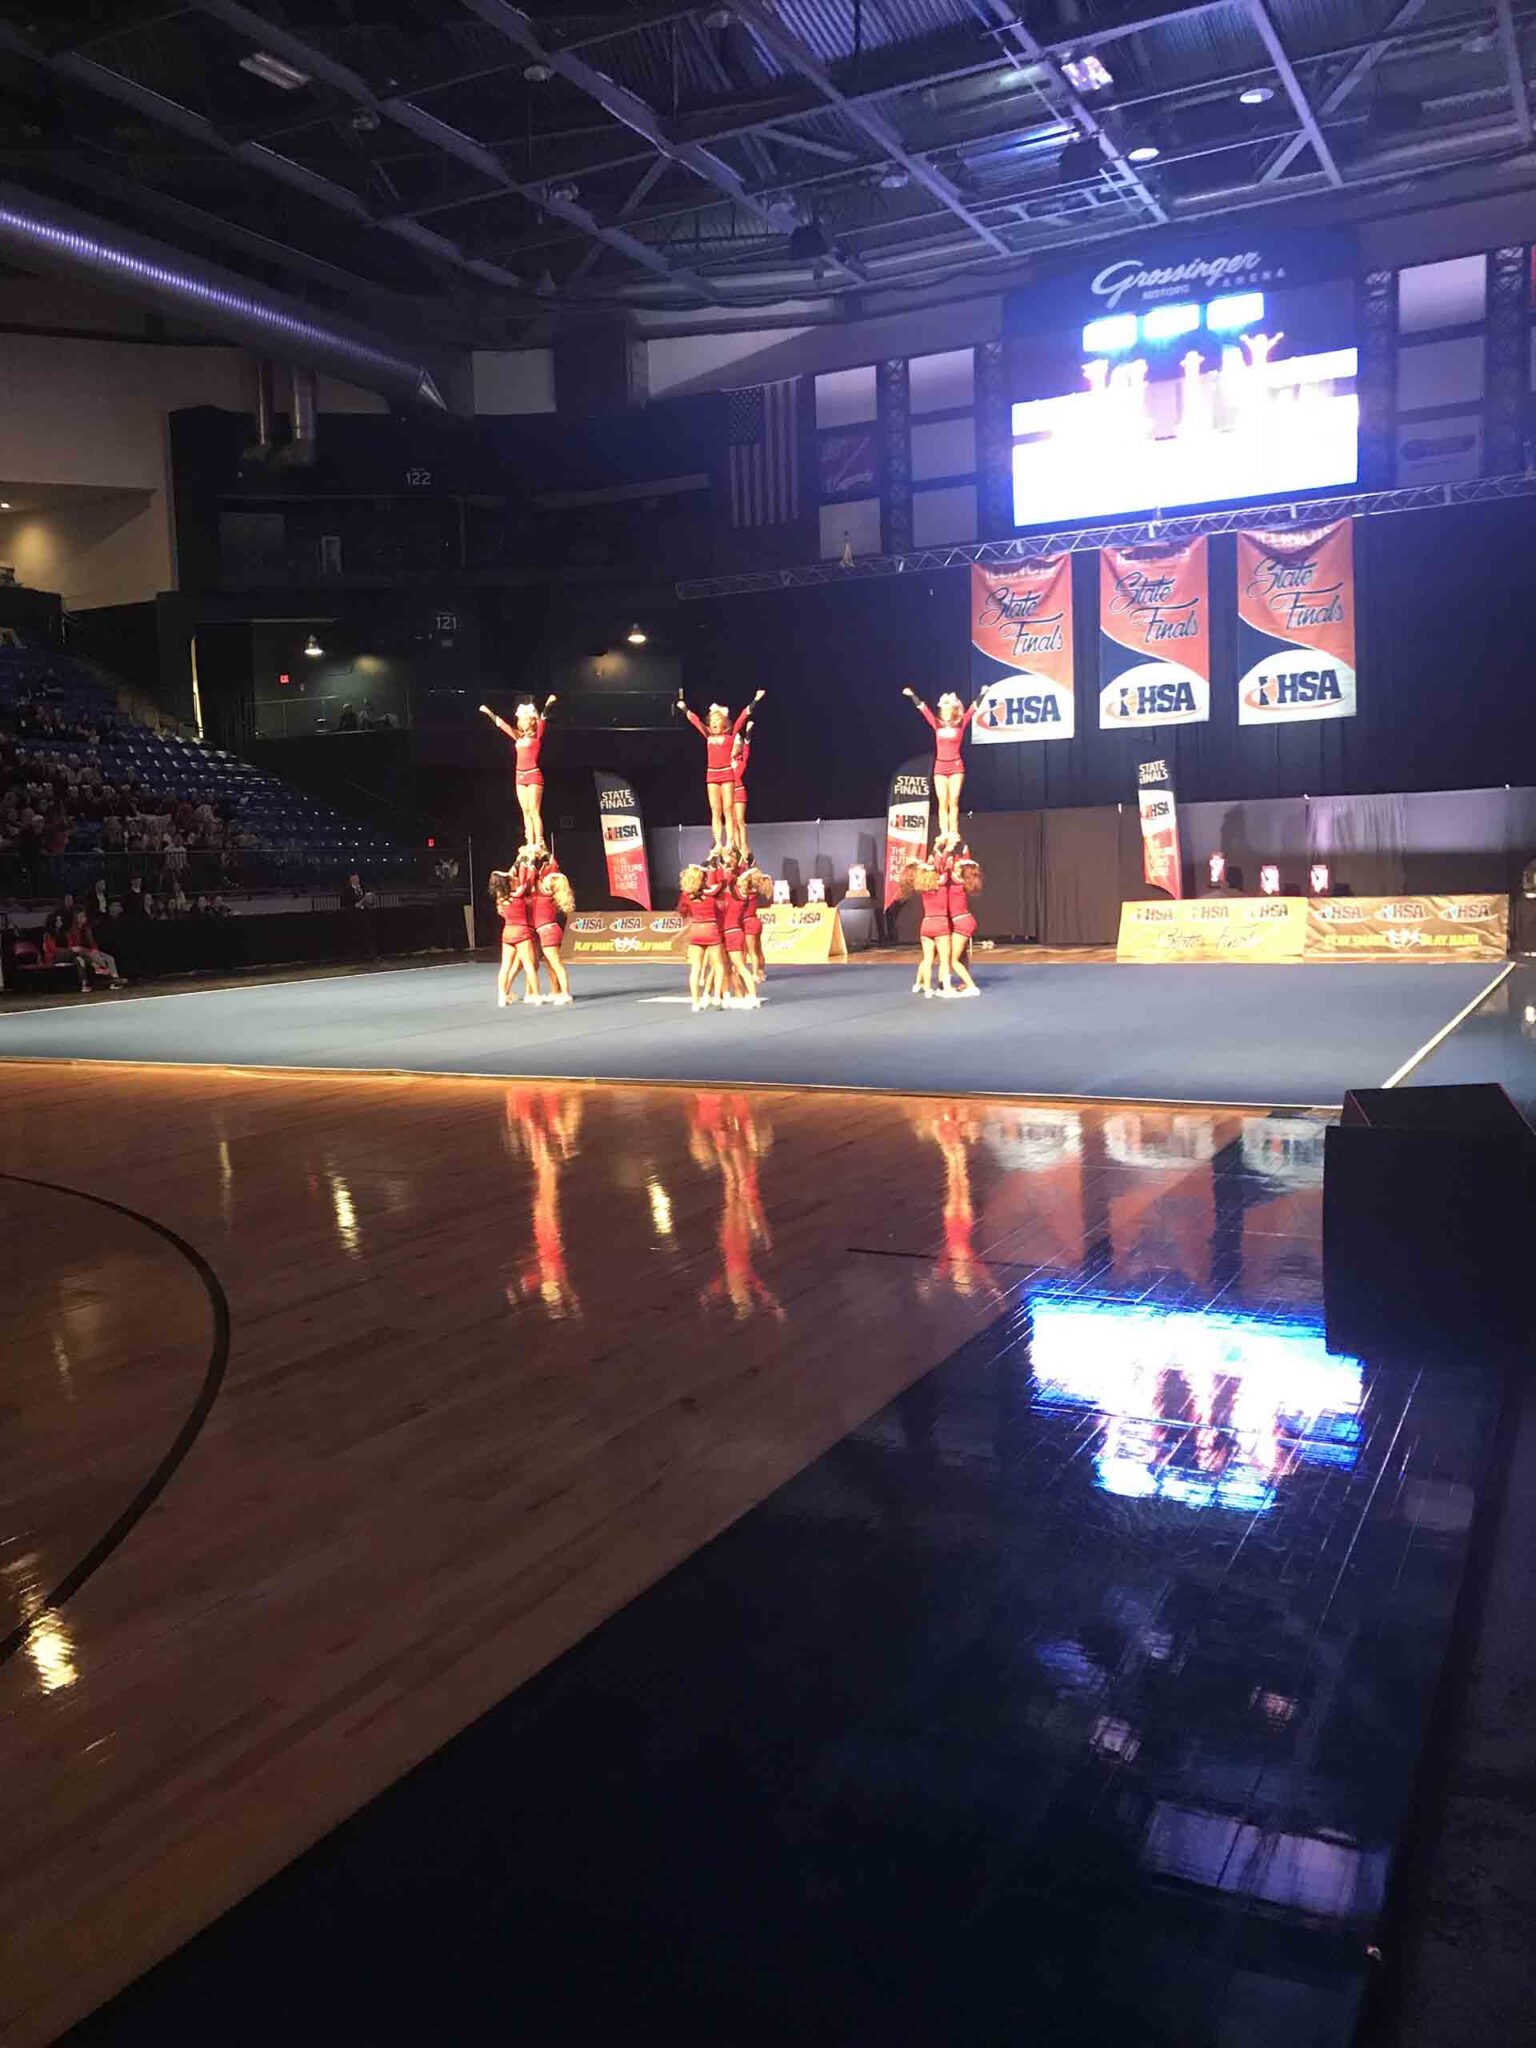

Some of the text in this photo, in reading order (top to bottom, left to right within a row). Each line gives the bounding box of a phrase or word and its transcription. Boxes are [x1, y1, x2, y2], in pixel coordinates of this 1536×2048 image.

[1091, 251, 1262, 309] Grossinger
[1222, 267, 1286, 288] ARENA
[406, 471, 432, 486] 122
[1247, 556, 1318, 598] State
[1109, 572, 1176, 614] State
[979, 586, 1042, 626] State
[1268, 582, 1344, 629] Finals
[435, 615, 458, 630] 121
[1129, 597, 1200, 643] Finals
[999, 613, 1064, 656] Finals
[1139, 760, 1166, 775] STATE
[897, 775, 927, 786] STATE
[1139, 768, 1169, 784] FINALS
[601, 789, 631, 801] STATE
[894, 784, 930, 796] FINALS
[600, 797, 635, 810] FINALS
[613, 863, 643, 873] FUTURE
[614, 872, 639, 882] PLAYS
